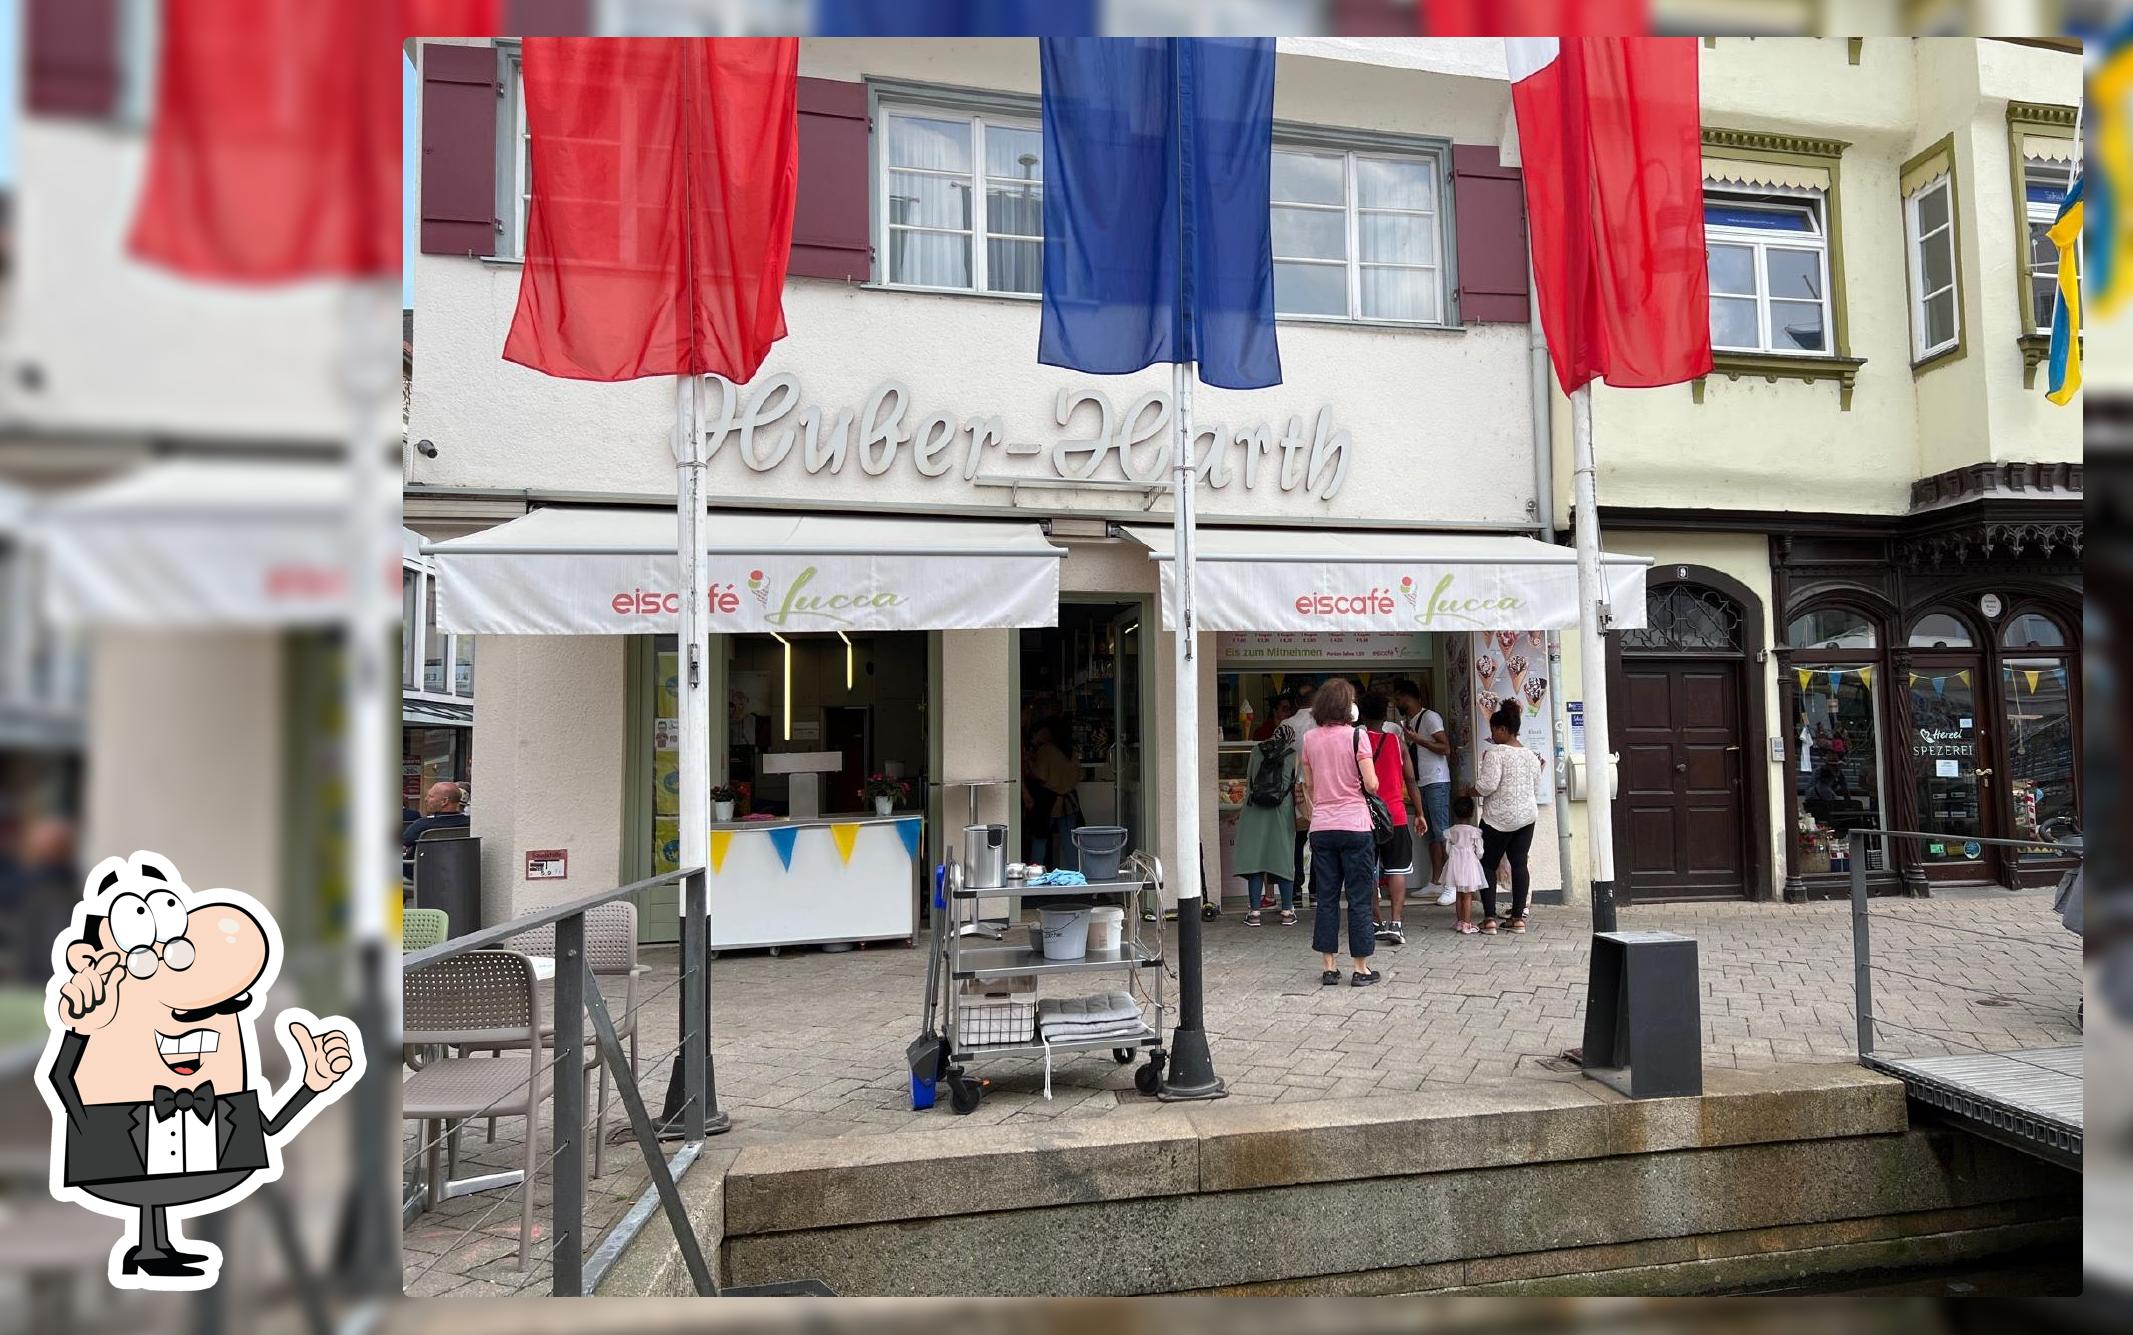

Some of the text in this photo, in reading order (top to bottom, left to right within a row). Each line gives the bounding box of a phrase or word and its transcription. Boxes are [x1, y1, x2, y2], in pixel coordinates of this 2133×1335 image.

[611, 566, 909, 625] eiscfé Lucca
[1295, 573, 1527, 625] eiscafé Lucca
[1225, 647, 1239, 657] Eis
[1244, 649, 1264, 657] zum
[1266, 647, 1322, 657] Mitnehmen
[1912, 745, 1973, 756] SPEZEREI
